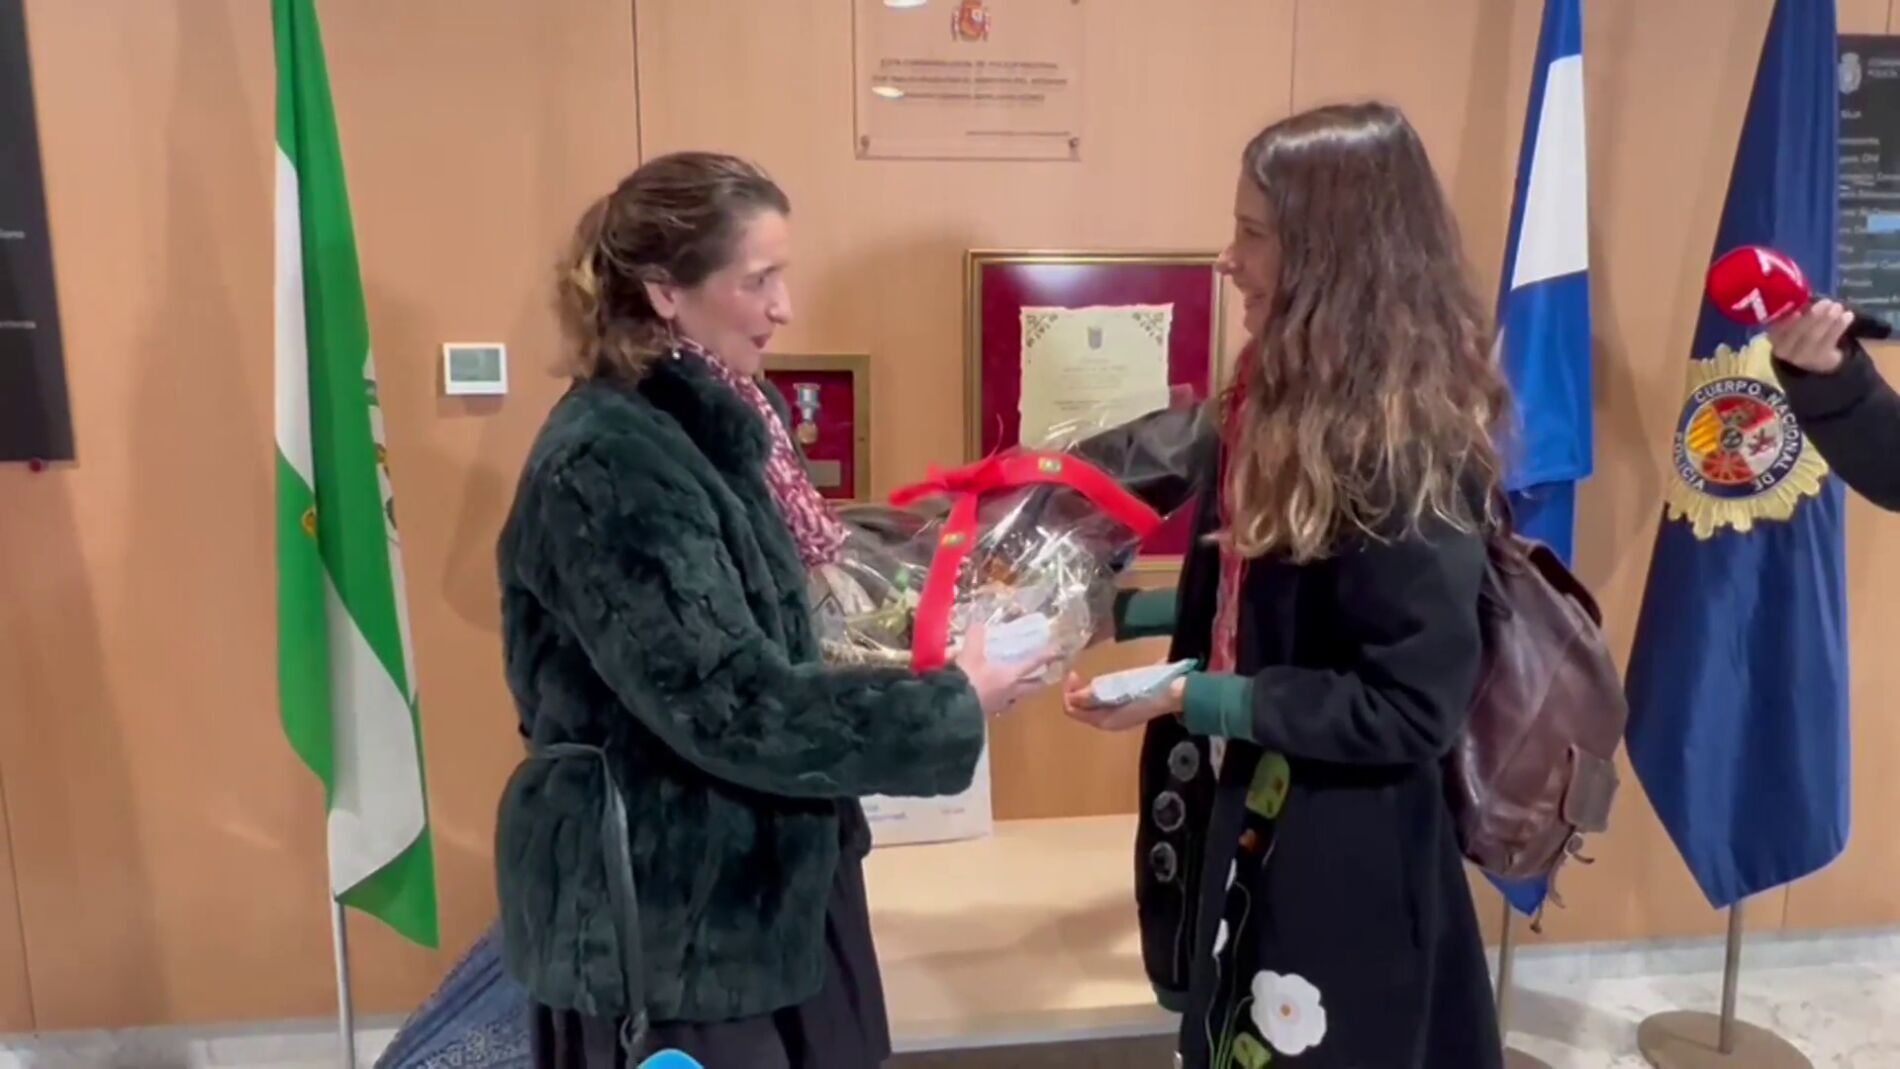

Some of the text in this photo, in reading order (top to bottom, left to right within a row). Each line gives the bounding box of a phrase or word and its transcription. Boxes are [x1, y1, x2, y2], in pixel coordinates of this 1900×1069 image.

[1694, 379, 1761, 404] CUERPO
[1766, 393, 1800, 471] NACIONAL
[1753, 475, 1776, 492] DE
